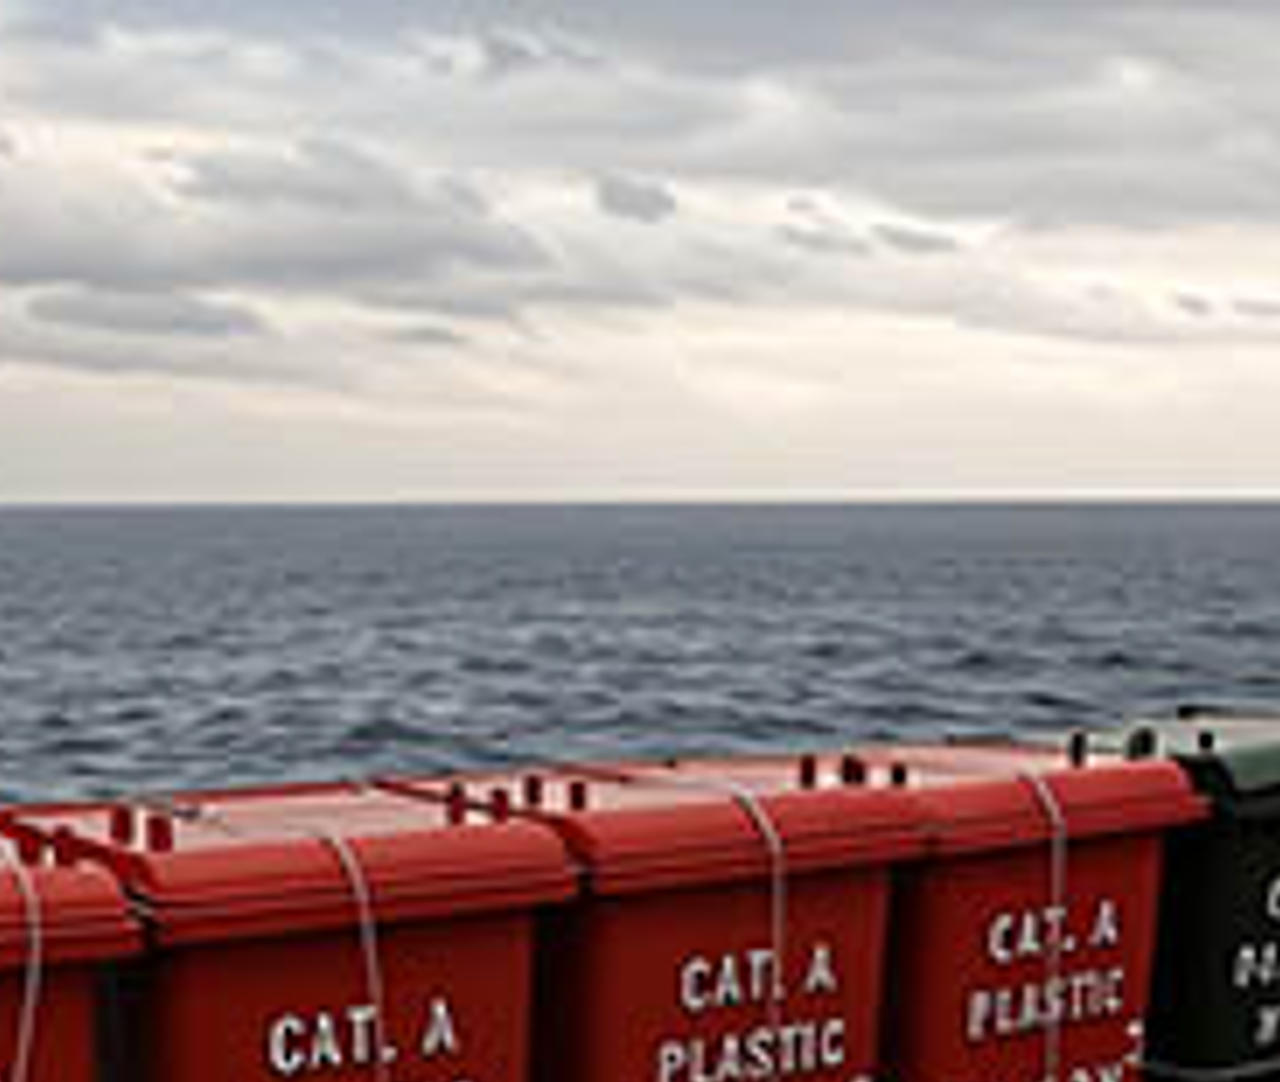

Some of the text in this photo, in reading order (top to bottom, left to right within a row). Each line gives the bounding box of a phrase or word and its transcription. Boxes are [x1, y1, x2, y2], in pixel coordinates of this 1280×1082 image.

[1088, 899, 1117, 946] A
[804, 944, 837, 994] A
[268, 998, 457, 1076] CAT. A
